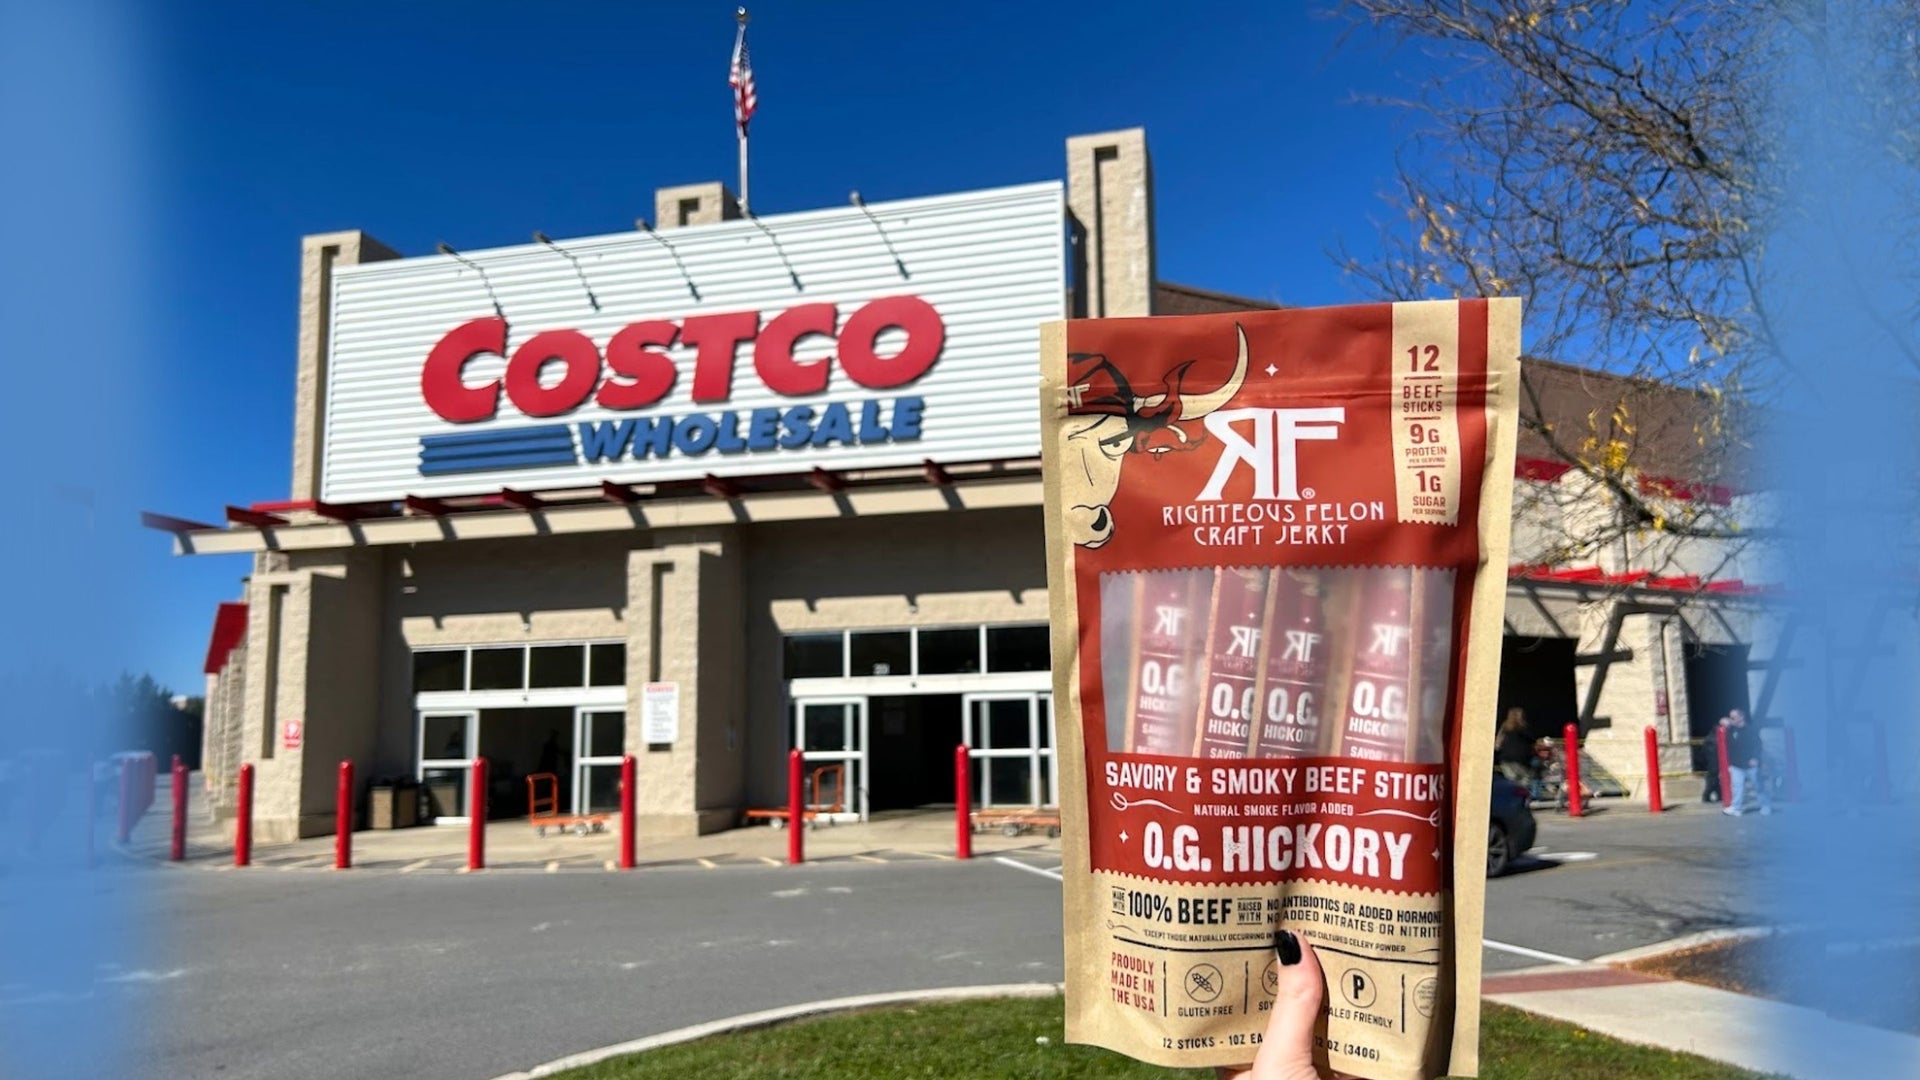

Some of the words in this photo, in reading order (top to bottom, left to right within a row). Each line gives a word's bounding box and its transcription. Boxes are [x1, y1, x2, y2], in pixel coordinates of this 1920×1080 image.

[421, 295, 946, 424] COSTCO
[1407, 345, 1439, 372] 12
[1403, 385, 1443, 399] BEEF
[1403, 401, 1442, 412] STICKS
[579, 396, 925, 465] WHOLESALE
[1406, 446, 1447, 457] PROTEIN
[1416, 470, 1441, 492] 1G
[1413, 496, 1446, 507] SUGAR
[1162, 503, 1295, 526] RIGHTEOUS
[1305, 501, 1384, 522] FELON
[1194, 525, 1264, 545] CRAFT
[1275, 524, 1349, 545] JERKY
[1106, 761, 1177, 792] SAVORY
[1186, 767, 1202, 794] &
[1212, 767, 1297, 795] SMOKY
[1305, 766, 1366, 795] BEEF
[1194, 804, 1240, 816] NATURAL
[1244, 804, 1278, 816] SMOKE
[1282, 802, 1316, 816] FLAVOR
[1321, 803, 1354, 816] ADDED
[1143, 821, 1212, 872] O.G.
[1222, 823, 1412, 880] HICKORY
[1128, 890, 1172, 923] 100%
[1178, 898, 1232, 925] BEEF
[1237, 902, 1262, 911] RAISED
[1238, 912, 1261, 922] WITH
[1267, 899, 1279, 911] NO
[1282, 896, 1339, 912] ANTIBIOTICS
[1343, 903, 1355, 914] OR
[1359, 905, 1392, 921] ADDED
[1267, 913, 1279, 924] NO
[1283, 910, 1319, 921] ADDED
[1323, 914, 1374, 933] NITRATES
[1379, 925, 1394, 936] OR
[1167, 933, 1187, 942] THOSE
[1189, 933, 1227, 942] NATURALLY
[1228, 933, 1265, 941] OCCURRING
[1303, 930, 1317, 938] AND
[1318, 931, 1348, 944] CULTURED
[1349, 938, 1374, 948] CELERY
[1375, 943, 1406, 952] POWDER
[1112, 952, 1154, 976] PROUDLY
[1111, 970, 1138, 990] MADE
[1143, 979, 1154, 994] IN
[1353, 974, 1365, 999] P
[1111, 988, 1130, 1006] THE
[1134, 993, 1155, 1013] USA
[1178, 1006, 1210, 1017] GLUTEN
[1213, 1005, 1233, 1015] FREE
[1259, 1001, 1273, 1011] SOY
[1354, 1011, 1393, 1029] FRIENDLY
[1163, 1037, 1172, 1048] 12
[1177, 1036, 1215, 1049] STICKS
[1250, 1033, 1263, 1044] EA
[1327, 1040, 1339, 1051] OZ
[1344, 1044, 1380, 1061] (340G)
